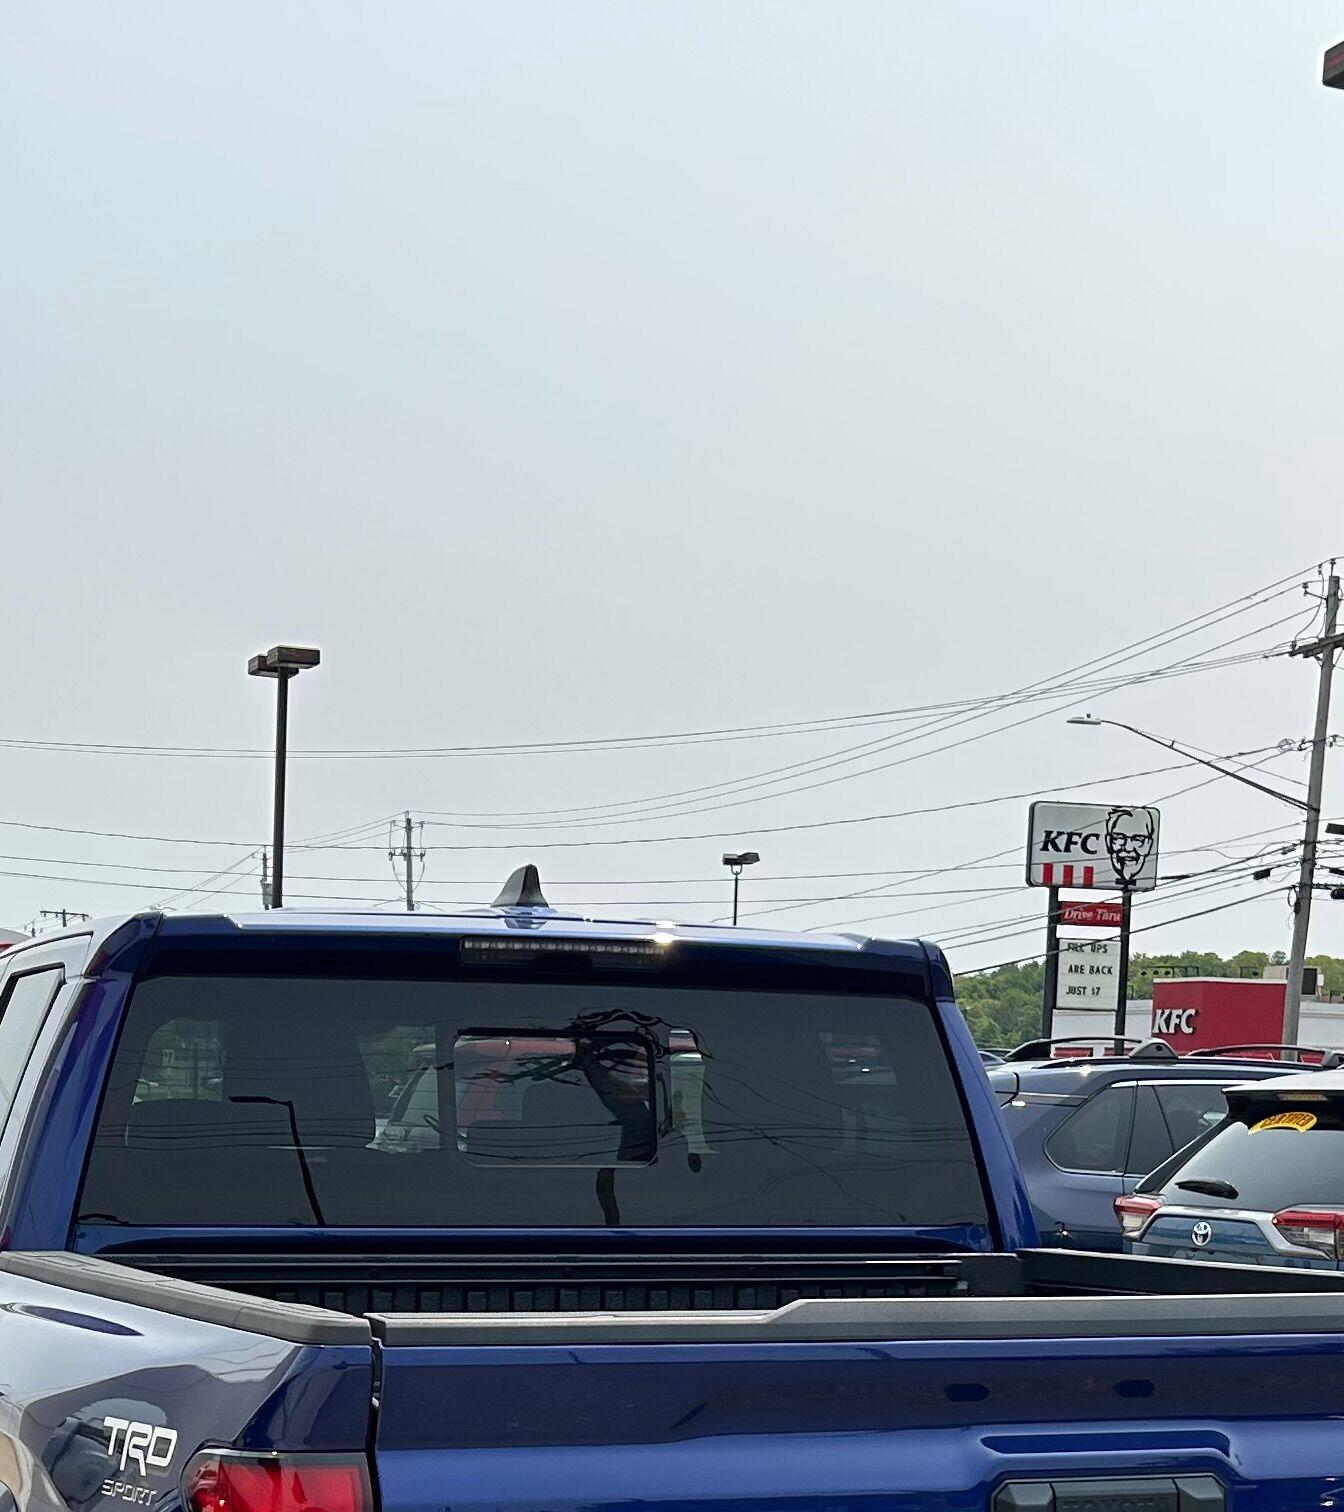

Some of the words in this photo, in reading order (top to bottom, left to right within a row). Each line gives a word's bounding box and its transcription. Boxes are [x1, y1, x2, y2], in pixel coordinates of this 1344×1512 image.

[1040, 830, 1100, 854] KFC
[1064, 908, 1093, 920] Drive
[1096, 908, 1121, 921] Thru
[1090, 943, 1108, 953] UPS
[1068, 964, 1085, 974] ARE
[1089, 965, 1113, 975] BACK
[1066, 986, 1087, 996] JUST
[1152, 1008, 1196, 1034] KFC
[103, 1416, 178, 1477] TRD
[101, 1479, 157, 1506] SPORT
